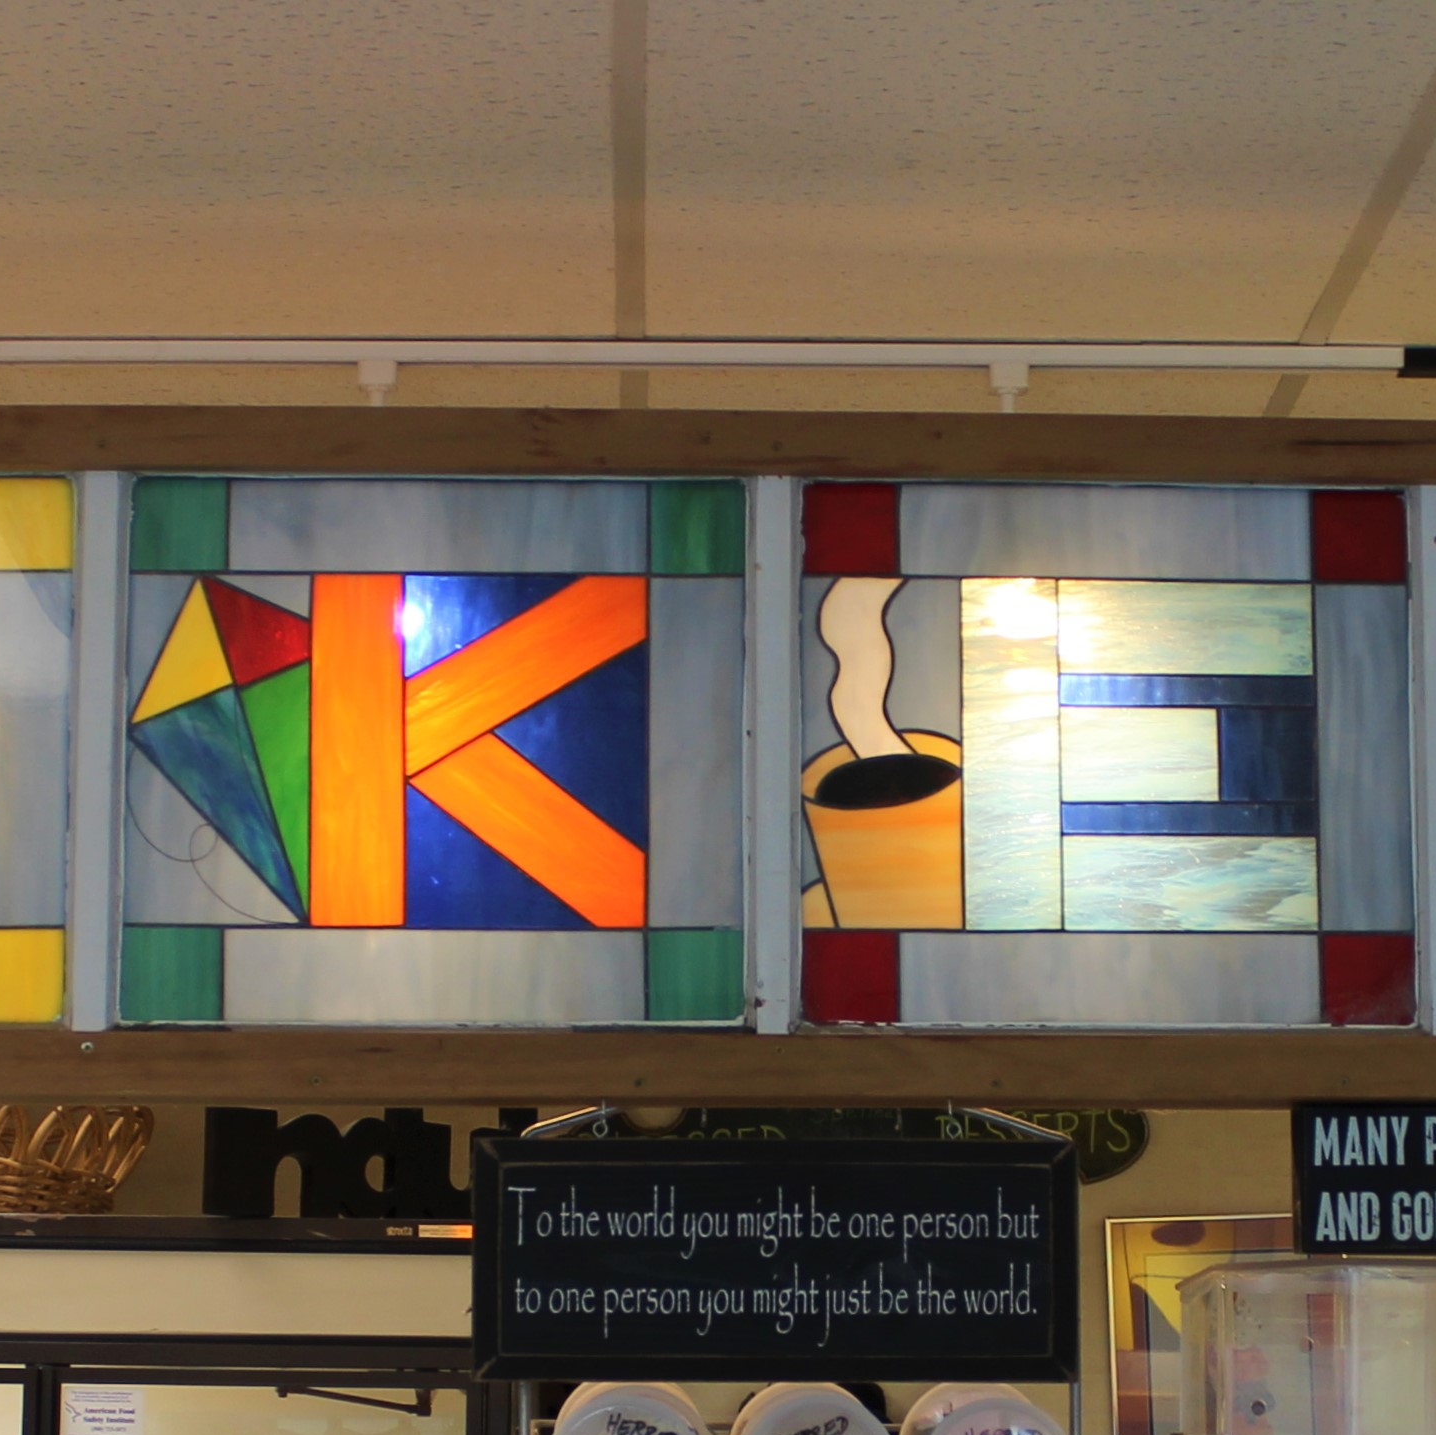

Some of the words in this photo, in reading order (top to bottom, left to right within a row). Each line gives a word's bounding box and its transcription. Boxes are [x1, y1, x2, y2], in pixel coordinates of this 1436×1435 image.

[1314, 1115, 1409, 1166] MANY
[507, 1186, 553, 1246] To
[559, 1185, 600, 1238] the
[607, 1185, 675, 1238] world
[680, 1211, 729, 1260] you
[737, 1186, 803, 1258] might
[810, 1185, 841, 1239] be
[848, 1212, 895, 1239] one
[903, 1212, 990, 1263] person
[997, 1186, 1040, 1239] but
[1315, 1191, 1381, 1241] AND
[515, 1278, 541, 1314] to
[549, 1288, 595, 1314] one
[604, 1288, 691, 1339] person
[697, 1288, 744, 1336] you
[753, 1262, 819, 1334] might
[818, 1274, 871, 1347] just
[878, 1262, 908, 1315] be
[917, 1263, 957, 1315] the
[964, 1263, 1038, 1315] world.
